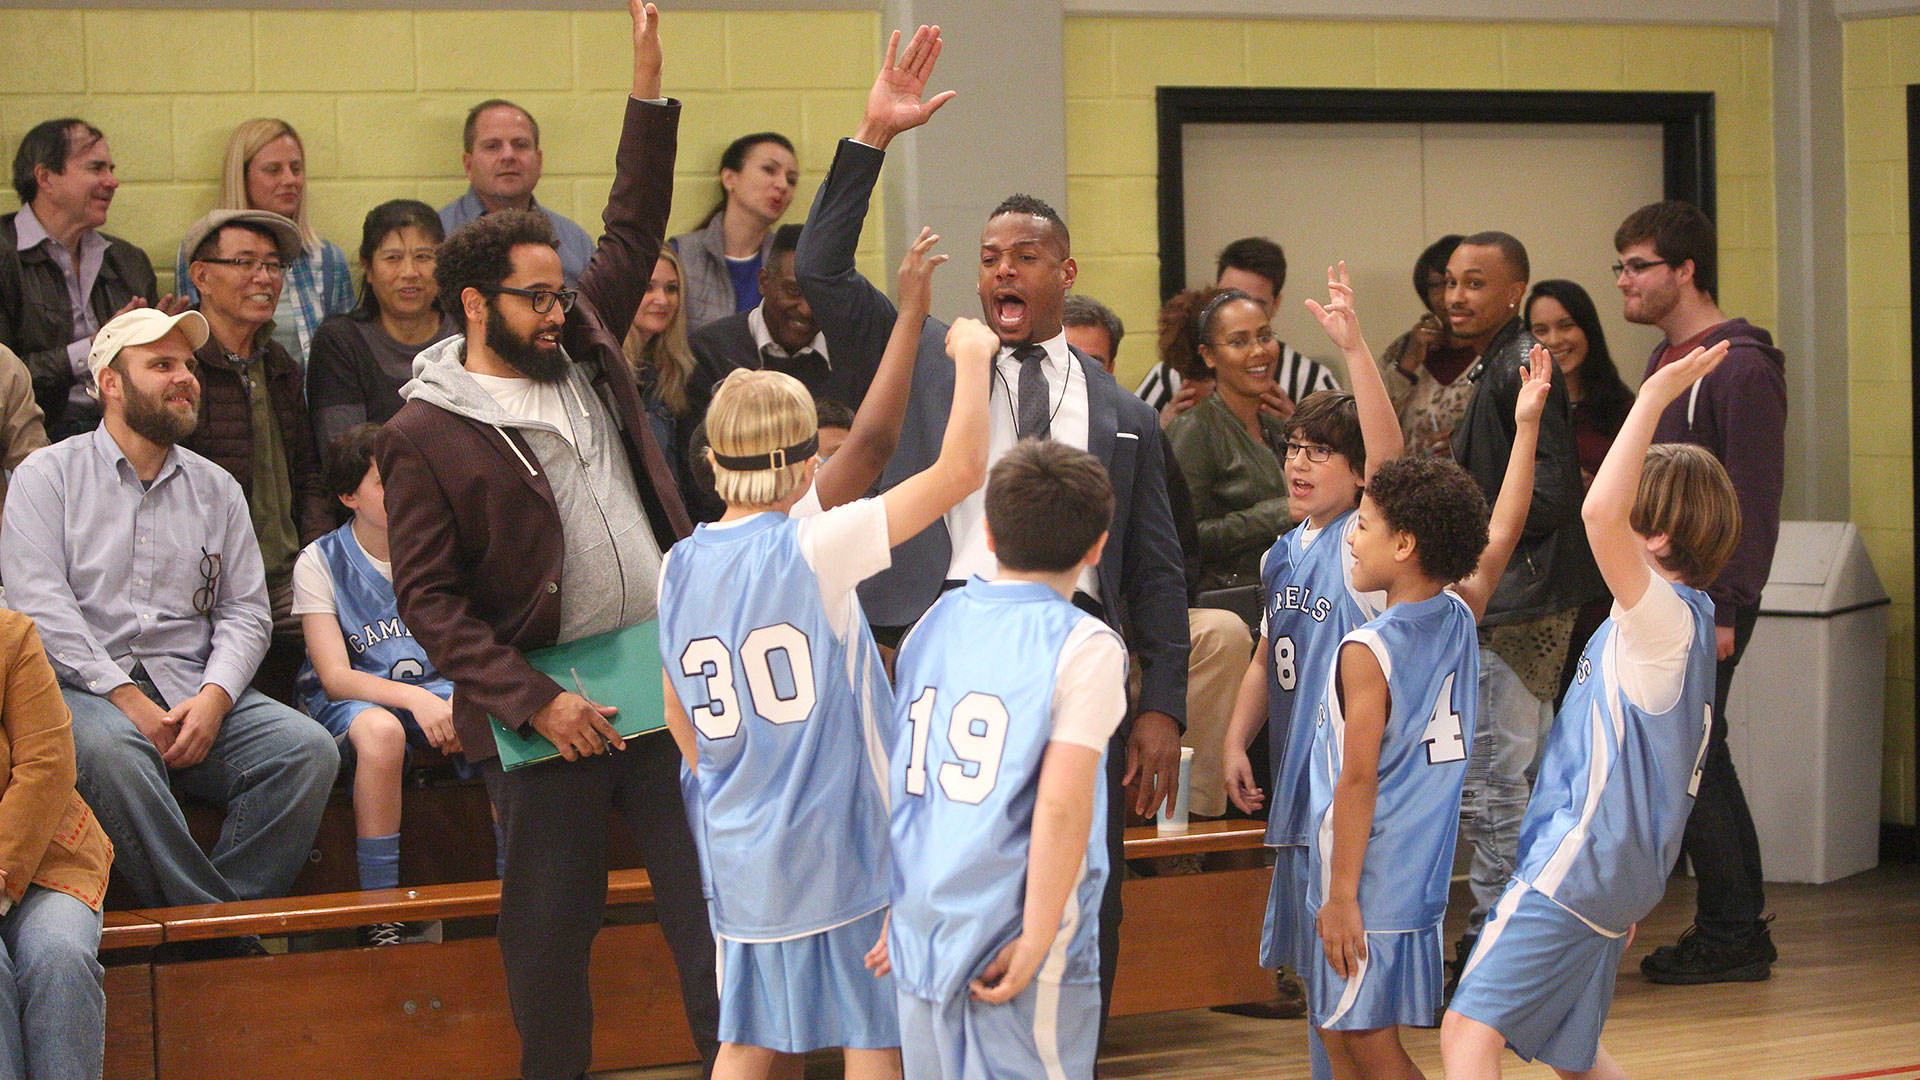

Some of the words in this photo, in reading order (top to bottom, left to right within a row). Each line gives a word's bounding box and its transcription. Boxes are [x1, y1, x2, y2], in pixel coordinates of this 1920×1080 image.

[680, 622, 817, 740] 30
[1274, 635, 1297, 691] 8
[906, 686, 1010, 805] 19
[1418, 669, 1467, 766] 4
